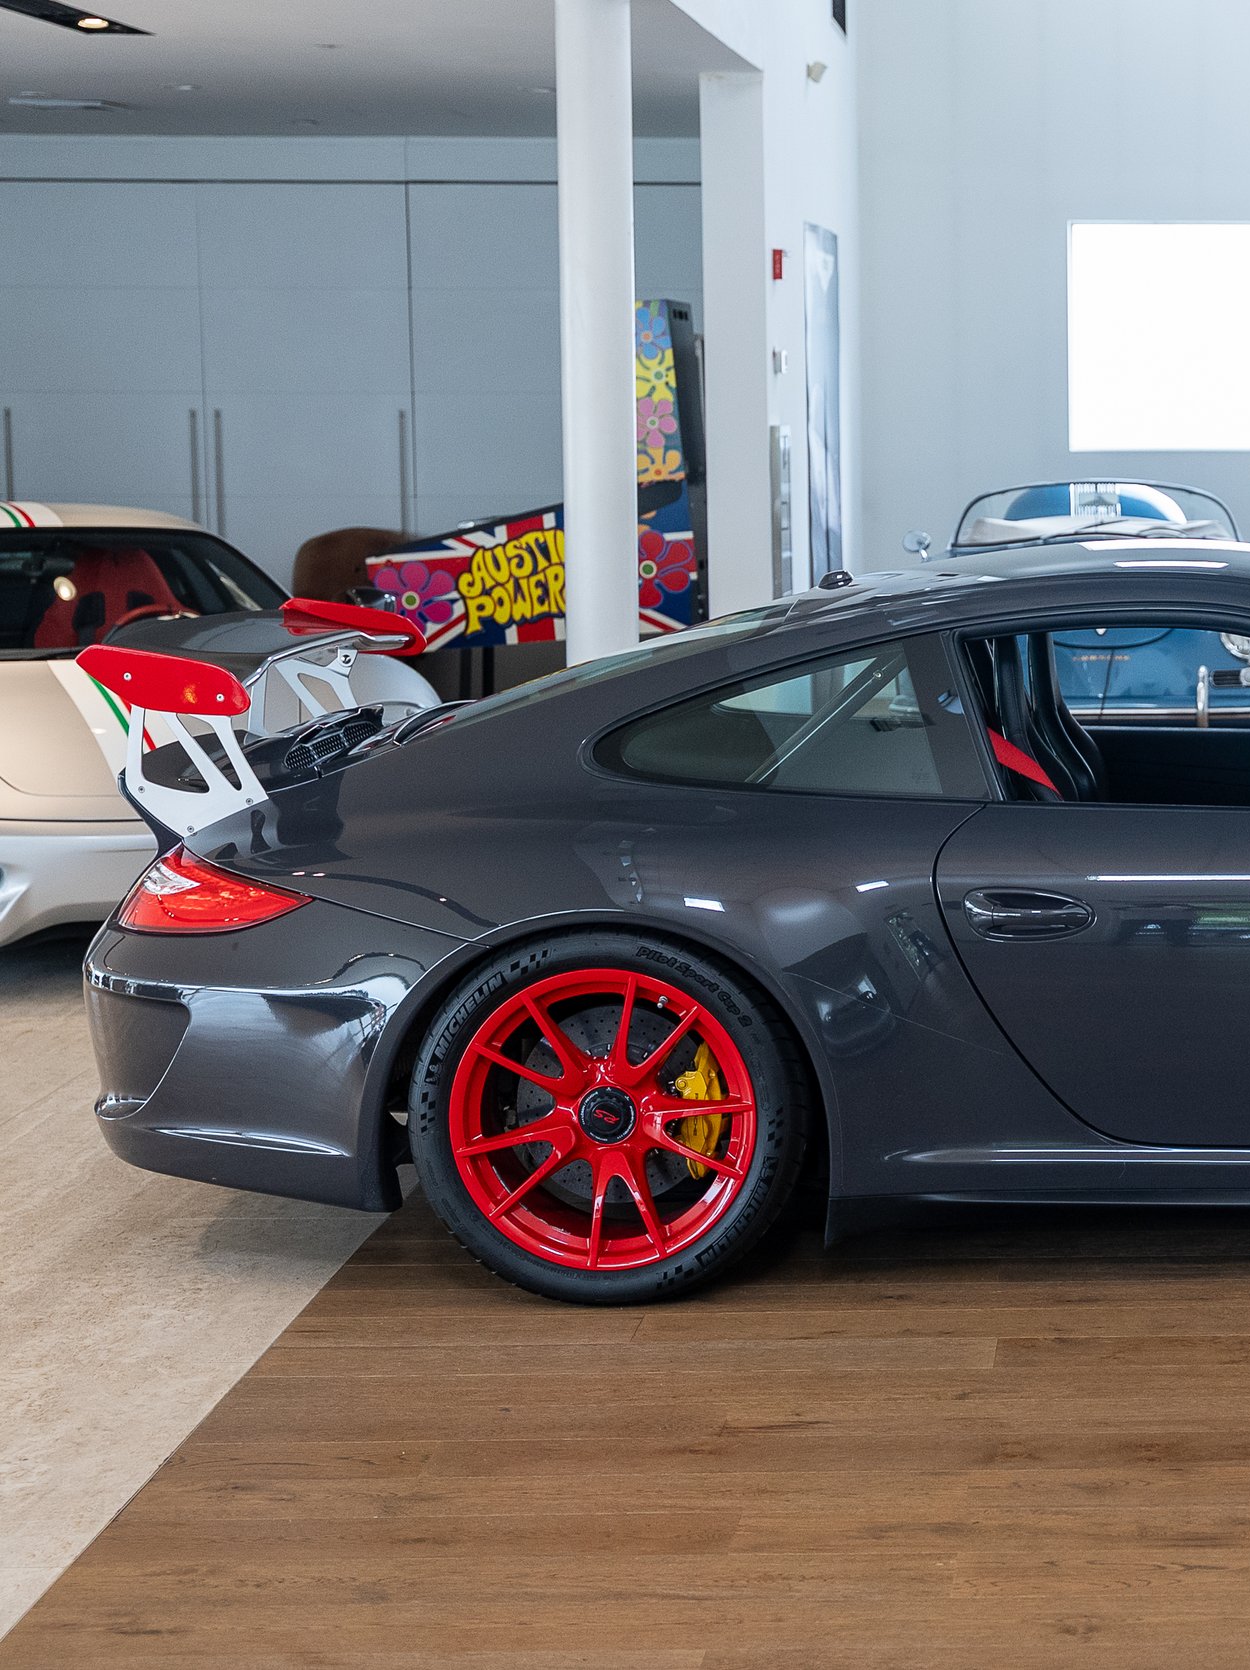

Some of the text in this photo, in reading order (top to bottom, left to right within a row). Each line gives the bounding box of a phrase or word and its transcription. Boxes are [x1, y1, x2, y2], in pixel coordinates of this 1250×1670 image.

[465, 564, 566, 636] POWER
[433, 975, 504, 1061] MICHELIN
[636, 946, 753, 1028] Pilot Sport Cup 2
[700, 1178, 769, 1267] MICHELIN
